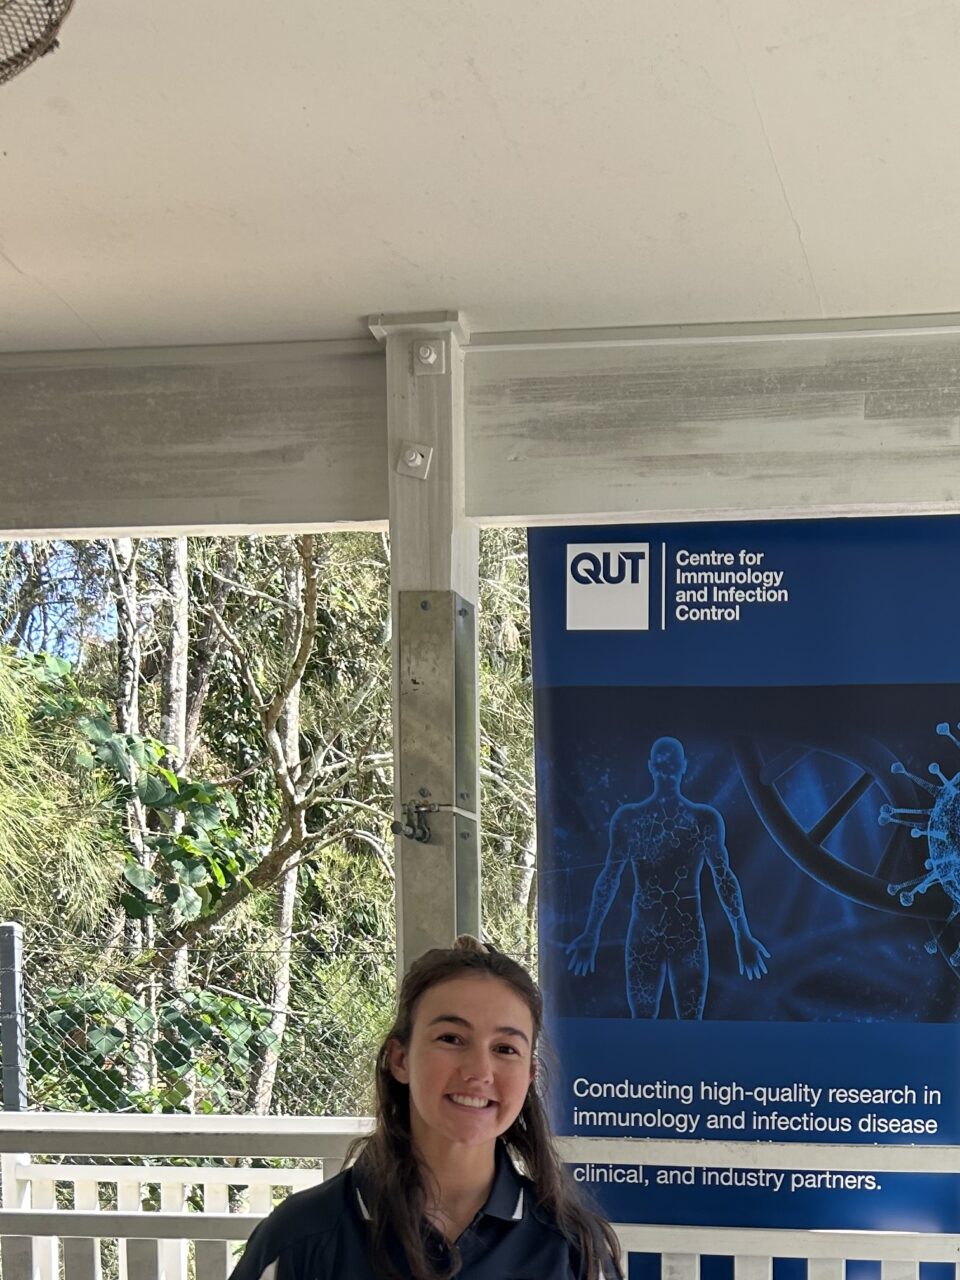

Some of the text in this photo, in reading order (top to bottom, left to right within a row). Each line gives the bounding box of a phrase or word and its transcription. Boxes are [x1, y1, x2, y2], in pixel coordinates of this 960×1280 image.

[570, 551, 646, 585] QUT
[676, 549, 765, 567] Centre for
[676, 568, 784, 588] Immunology
[675, 585, 789, 603] and Infection
[675, 604, 740, 622] Control
[573, 1078, 942, 1108] Conducting high-quality research in
[573, 1107, 938, 1134] immunology and infectious disease
[572, 1164, 883, 1193] clinical, and industry partners.
